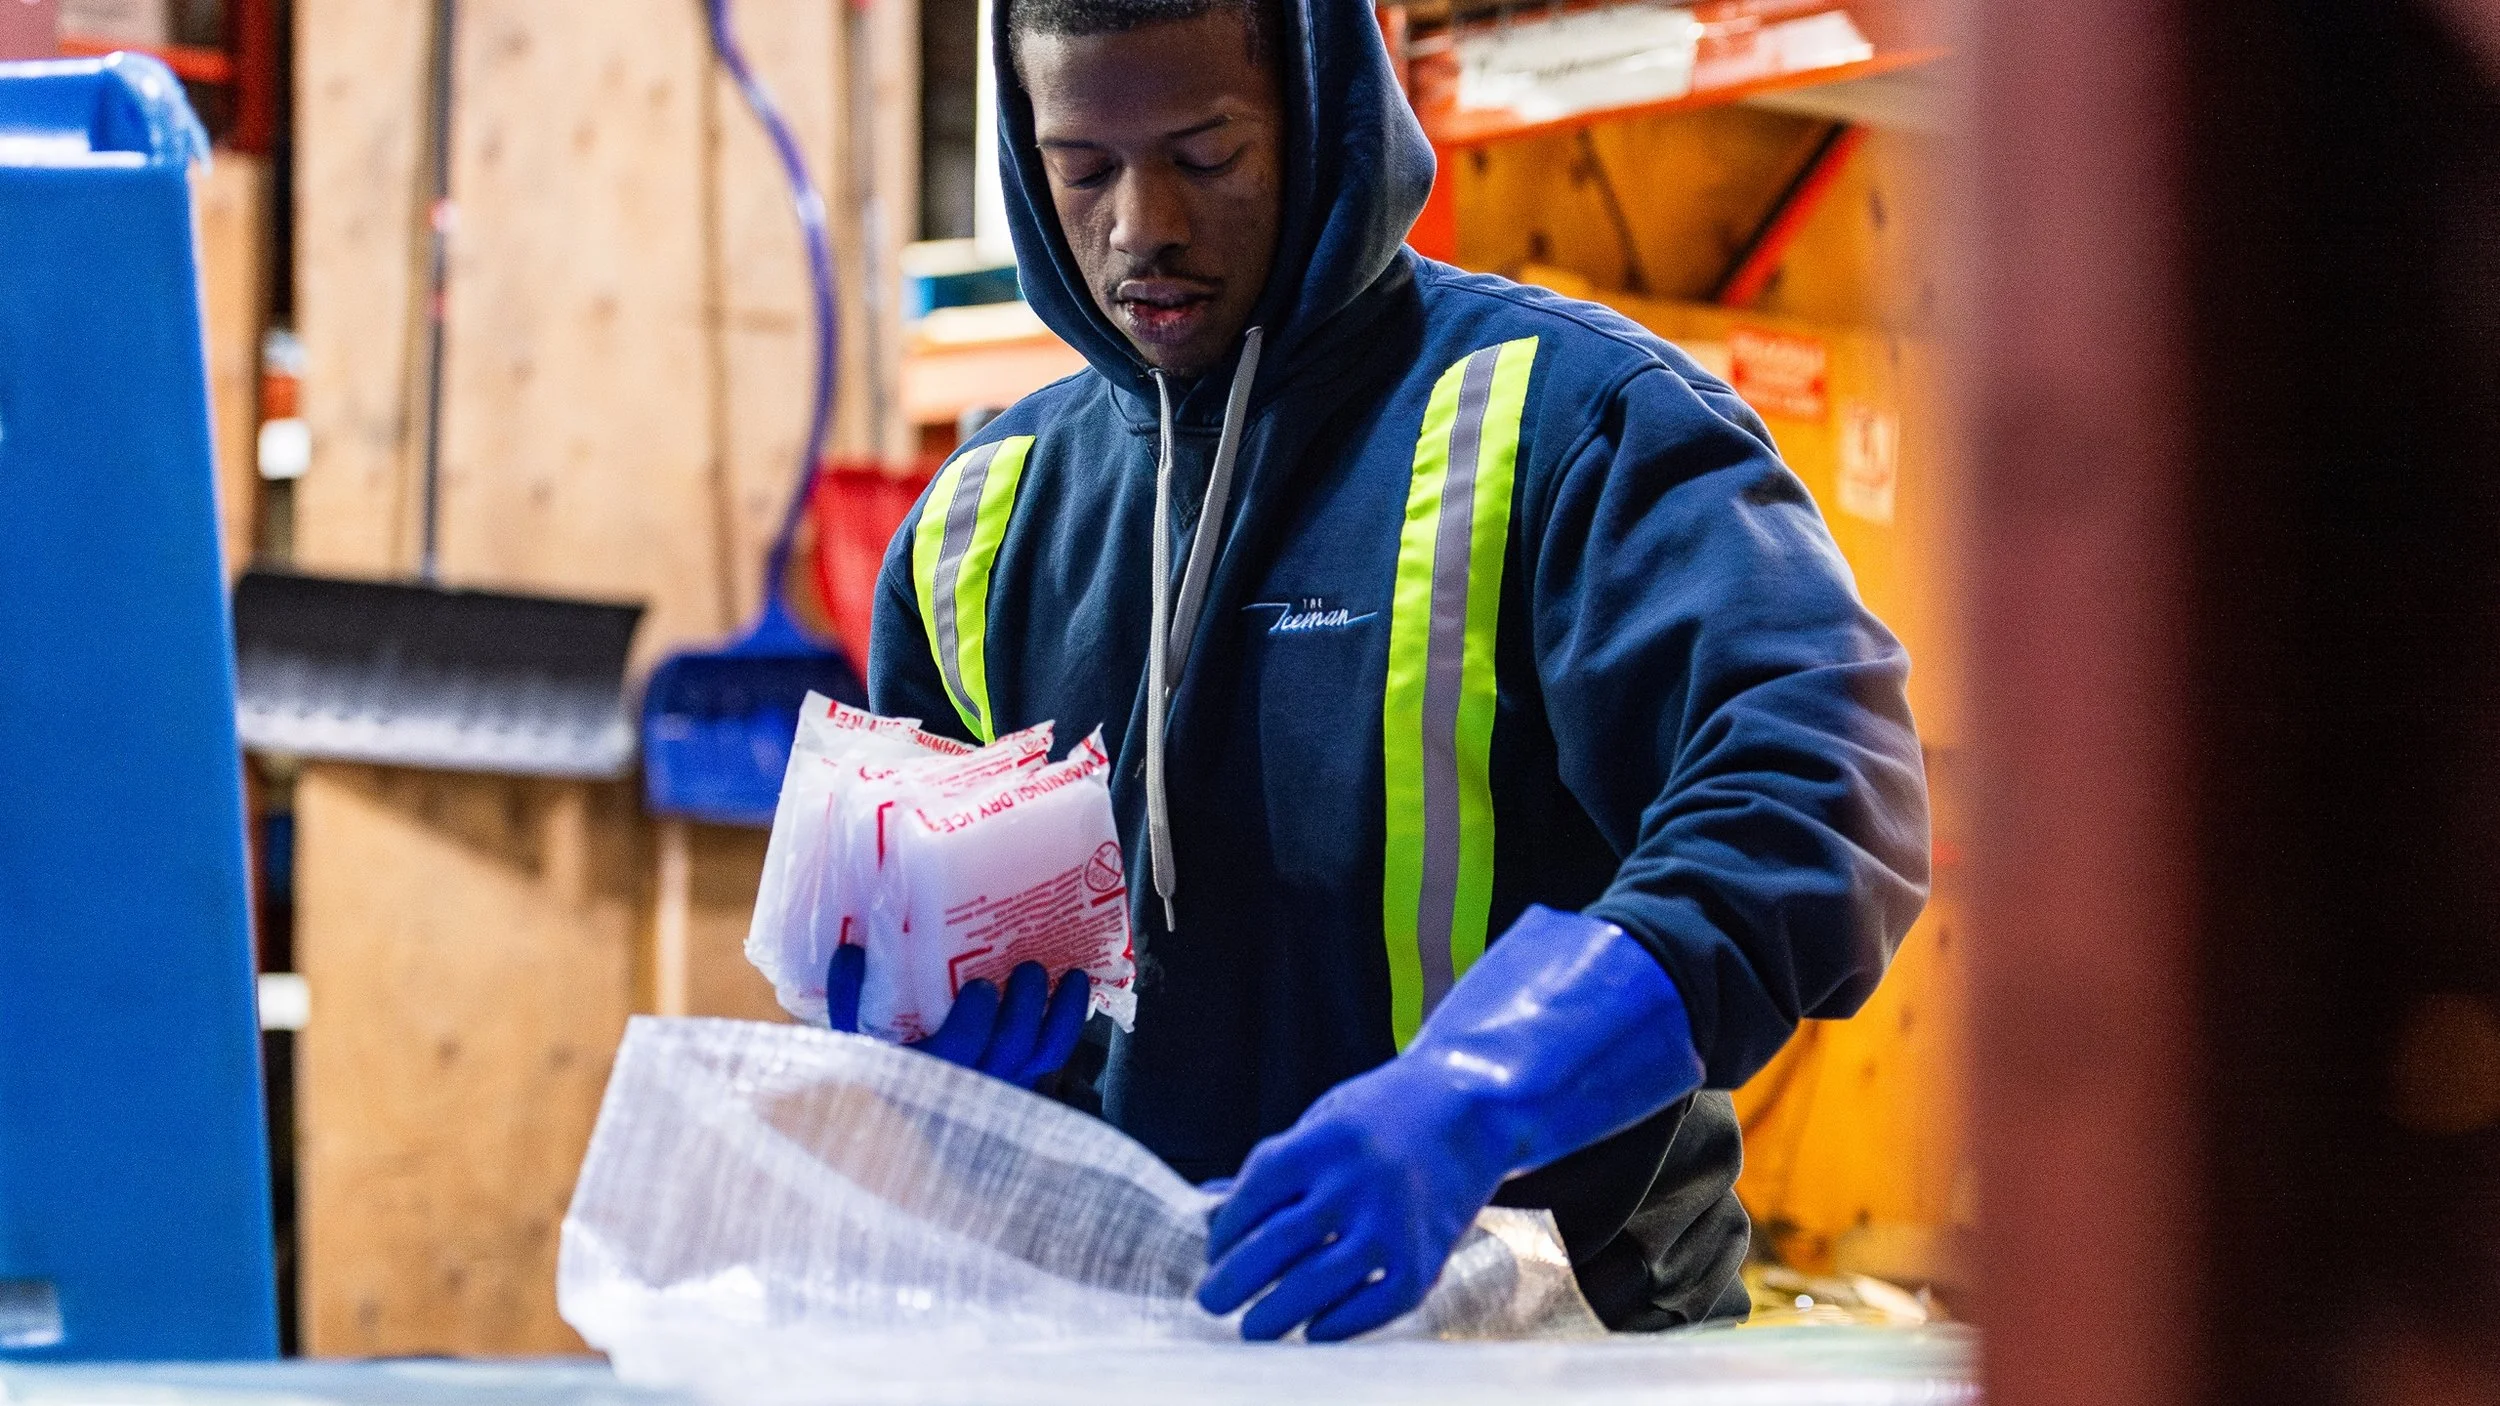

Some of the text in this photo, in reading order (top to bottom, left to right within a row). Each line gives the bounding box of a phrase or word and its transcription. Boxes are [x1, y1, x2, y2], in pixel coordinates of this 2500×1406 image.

[1302, 598, 1322, 609] THE
[1241, 602, 1378, 635] Iceman
[1015, 760, 1094, 804] WARNING!
[978, 793, 1014, 821] DRY
[940, 815, 975, 833] ICE
